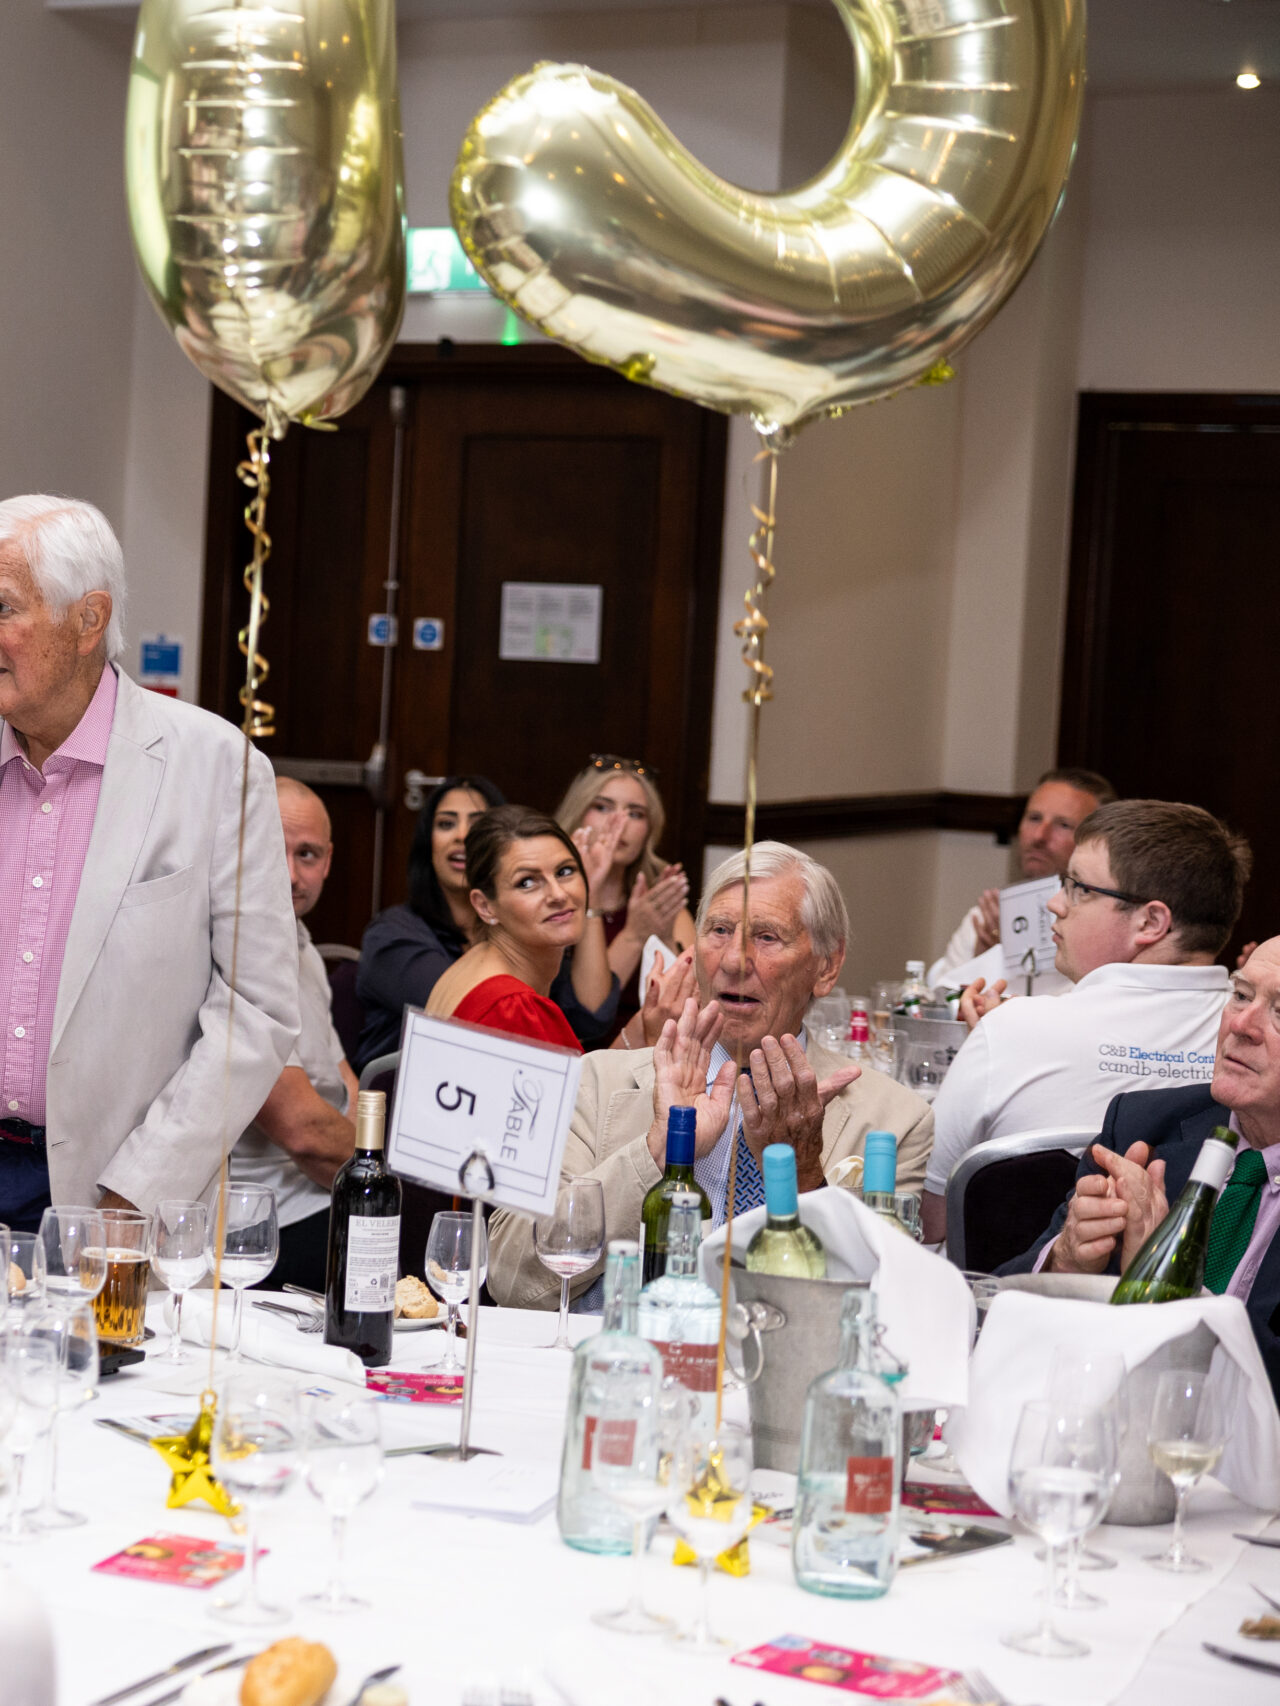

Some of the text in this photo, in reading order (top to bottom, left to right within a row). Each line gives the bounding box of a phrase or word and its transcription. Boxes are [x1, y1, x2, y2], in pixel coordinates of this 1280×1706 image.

[1098, 1044, 1127, 1057] C&B
[1129, 1047, 1184, 1062] Electrical
[435, 1081, 477, 1116] 5
[500, 1069, 544, 1161] TABLE
